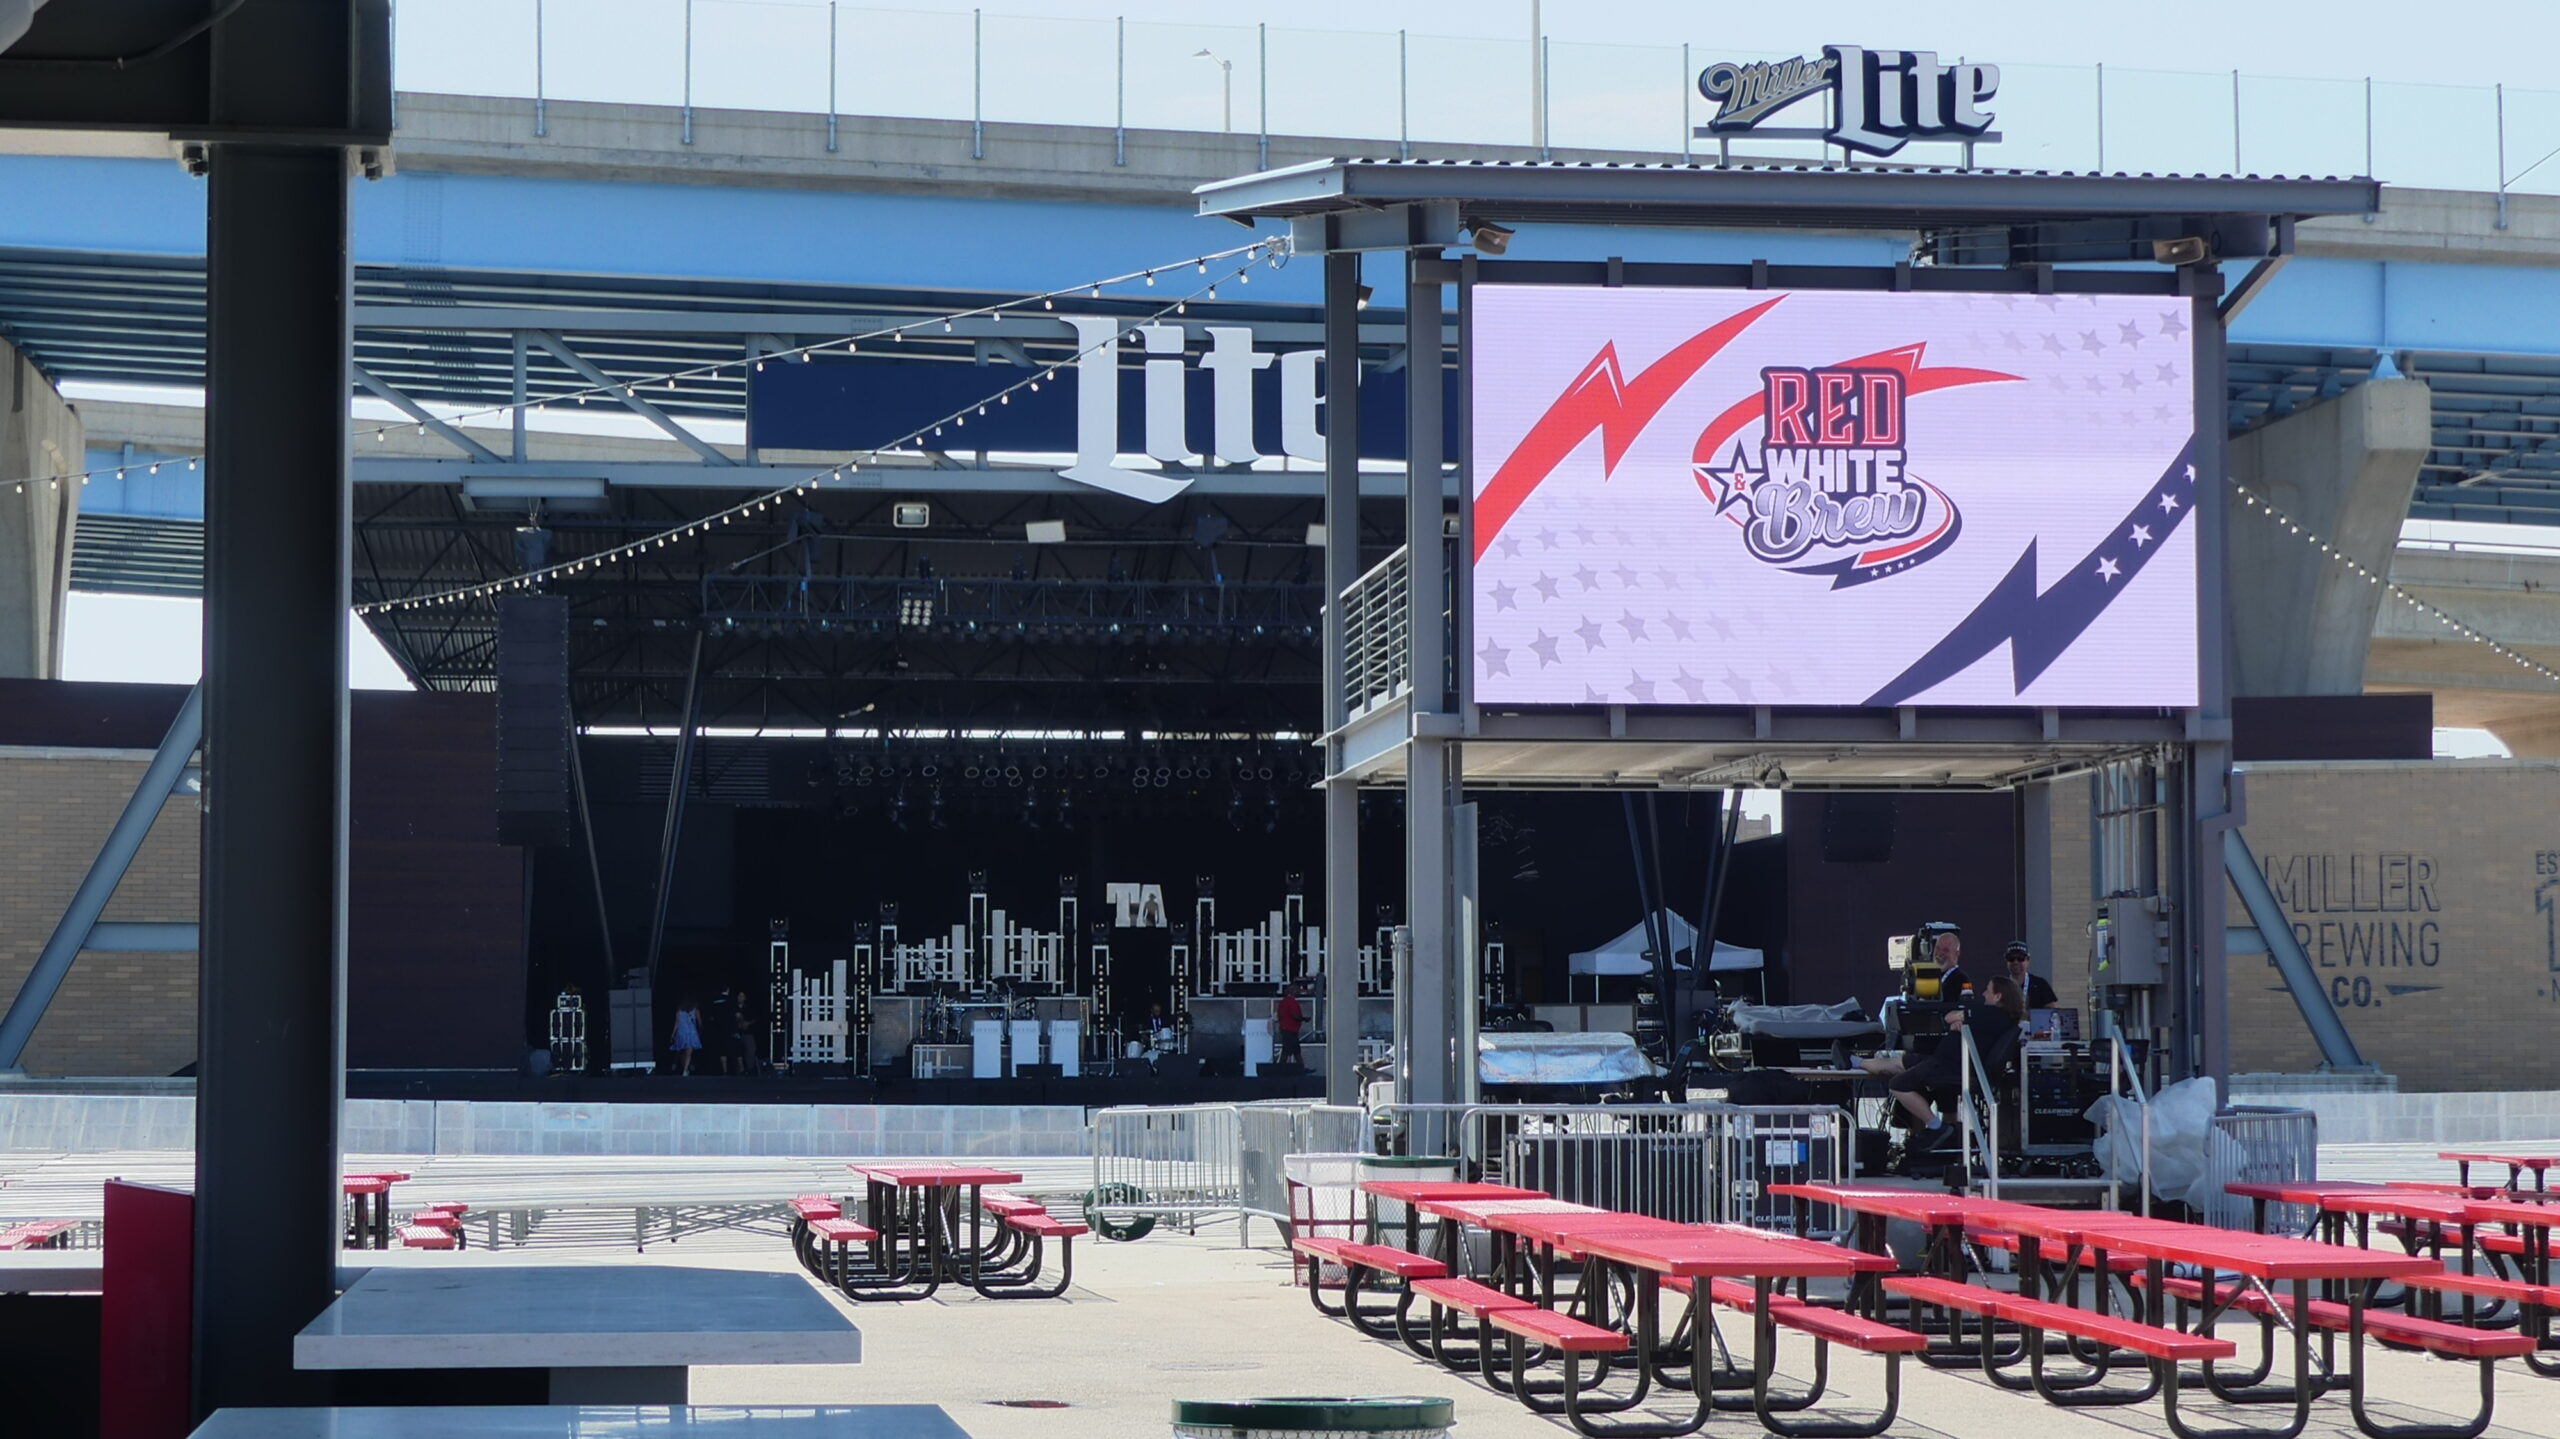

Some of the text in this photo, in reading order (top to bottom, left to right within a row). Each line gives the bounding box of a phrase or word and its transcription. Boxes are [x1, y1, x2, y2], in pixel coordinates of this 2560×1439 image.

[1698, 45, 2000, 158] Miller Lite
[1058, 316, 1361, 503] Lite
[1766, 372, 1901, 444] RED
[1765, 449, 1901, 493] WHITE
[1733, 473, 1918, 556] & Brew
[2265, 854, 2441, 912] MILLER
[2535, 851, 2560, 875] ES
[1106, 883, 1167, 928] TA
[2268, 922, 2440, 967] REWING
[2331, 976, 2382, 1008] CO.
